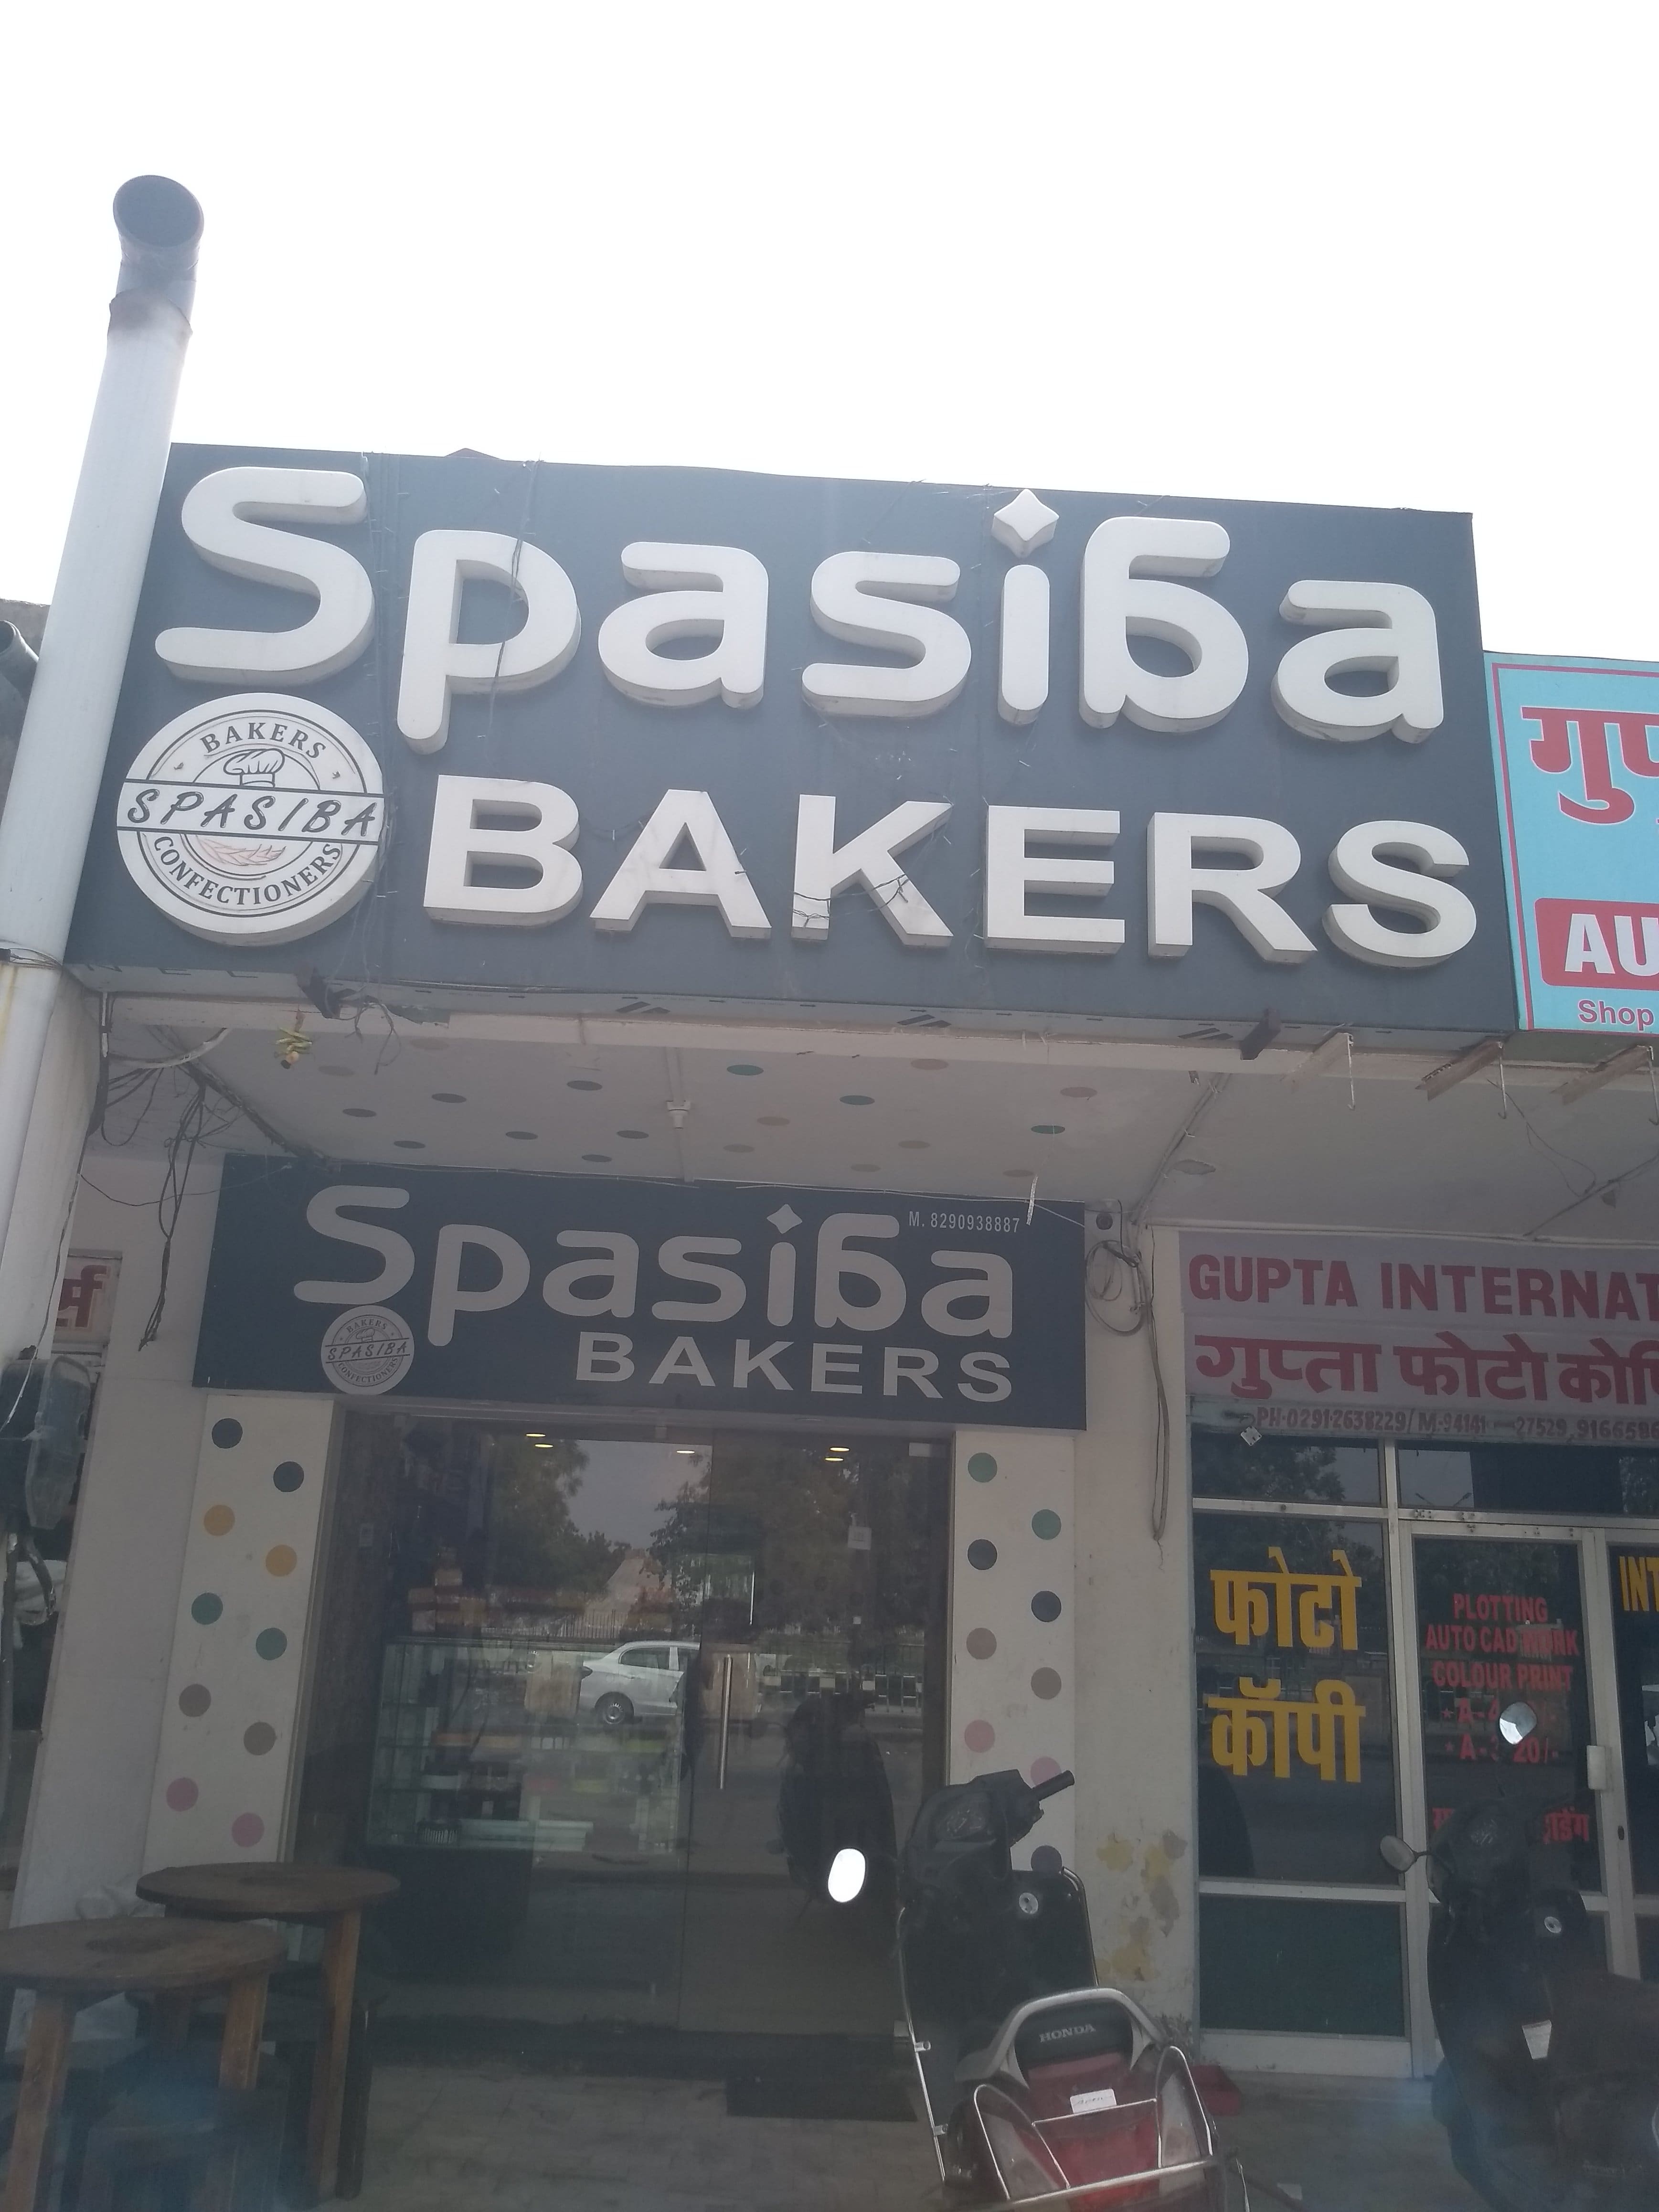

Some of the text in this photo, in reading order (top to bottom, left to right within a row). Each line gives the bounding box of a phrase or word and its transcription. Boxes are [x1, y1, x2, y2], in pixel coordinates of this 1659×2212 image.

[200, 723, 327, 758] BAKERS
[128, 789, 377, 836] SPASIBA
[154, 836, 340, 905] CONFECTIONERS
[424, 774, 1477, 967] BAKERS
[1564, 913, 1659, 977] AU
[1578, 999, 1654, 1031] Shop
[909, 1211, 1020, 1233] M. 8290938887
[1189, 1254, 1659, 1321] GUPTA INTERNAT
[346, 1319, 388, 1333] BAKERS
[328, 1341, 407, 1360] SPASIBA
[576, 1331, 1012, 1403] BAKERS
[1194, 1335, 1382, 1400] गुप्ता
[1393, 1331, 1548, 1400] फोटो
[338, 1357, 398, 1383] CONFECTIONERS
[1210, 1546, 1362, 1650] फोटो
[1453, 1593, 1548, 1623] PLOTTING
[1425, 1624, 1476, 1651] AUTO
[1479, 1626, 1517, 1654] CAD
[1432, 1659, 1574, 1691] COLOUR PRINT
[1207, 1677, 1366, 1783] कॉपी
[1039, 2023, 1096, 2043] HONDA
